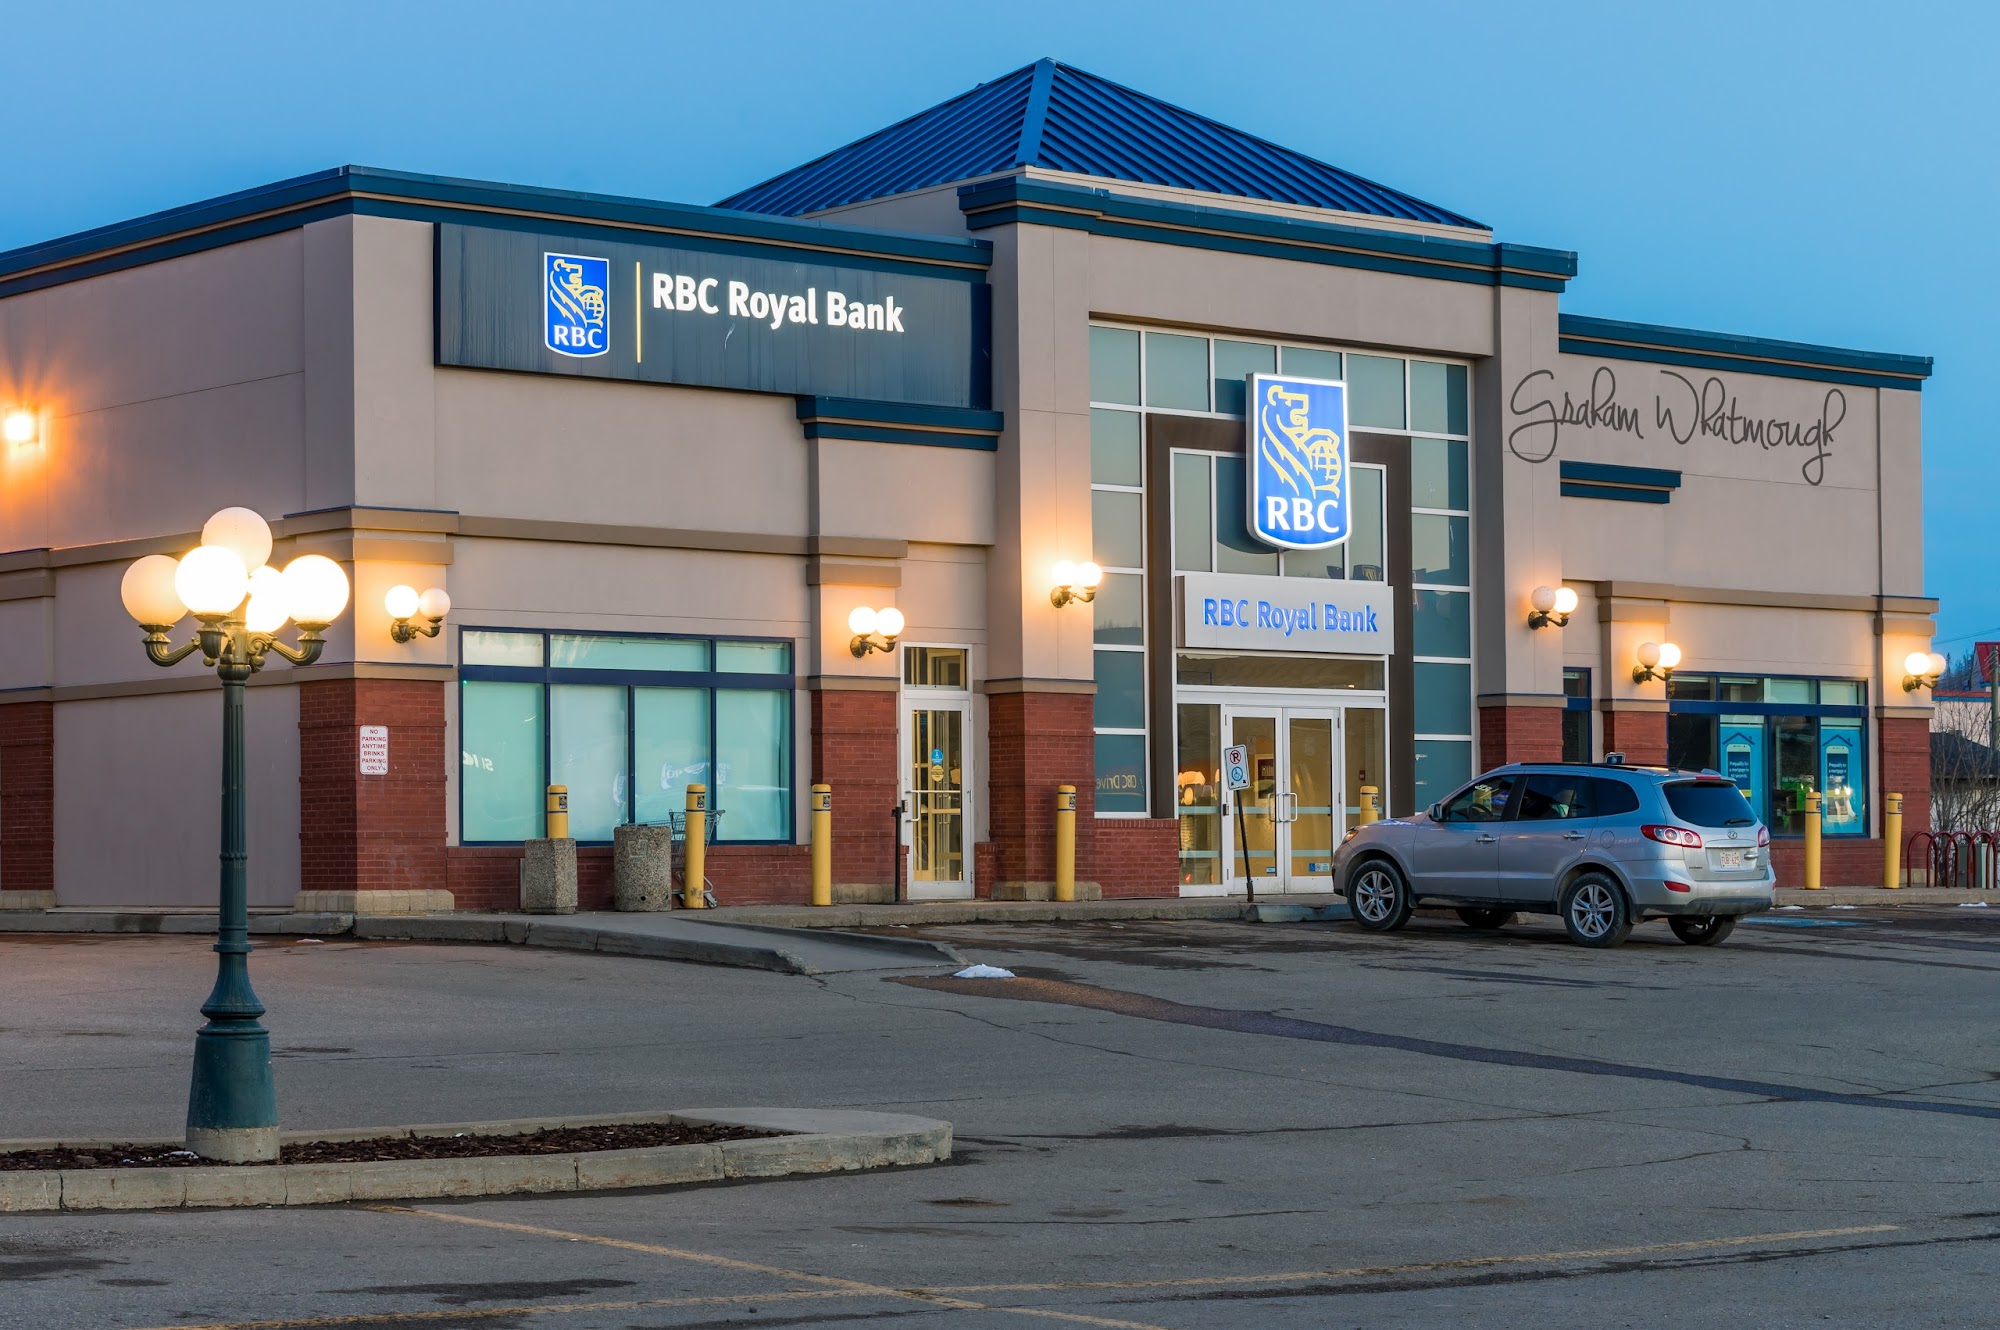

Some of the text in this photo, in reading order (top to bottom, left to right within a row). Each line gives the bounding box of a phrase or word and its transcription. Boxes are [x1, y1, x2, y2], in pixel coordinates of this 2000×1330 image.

[653, 272, 905, 332] RBC Royal Bank
[553, 324, 603, 349] RBC
[1266, 495, 1340, 534] RBC
[1203, 598, 1378, 637] RBC Royal Bank
